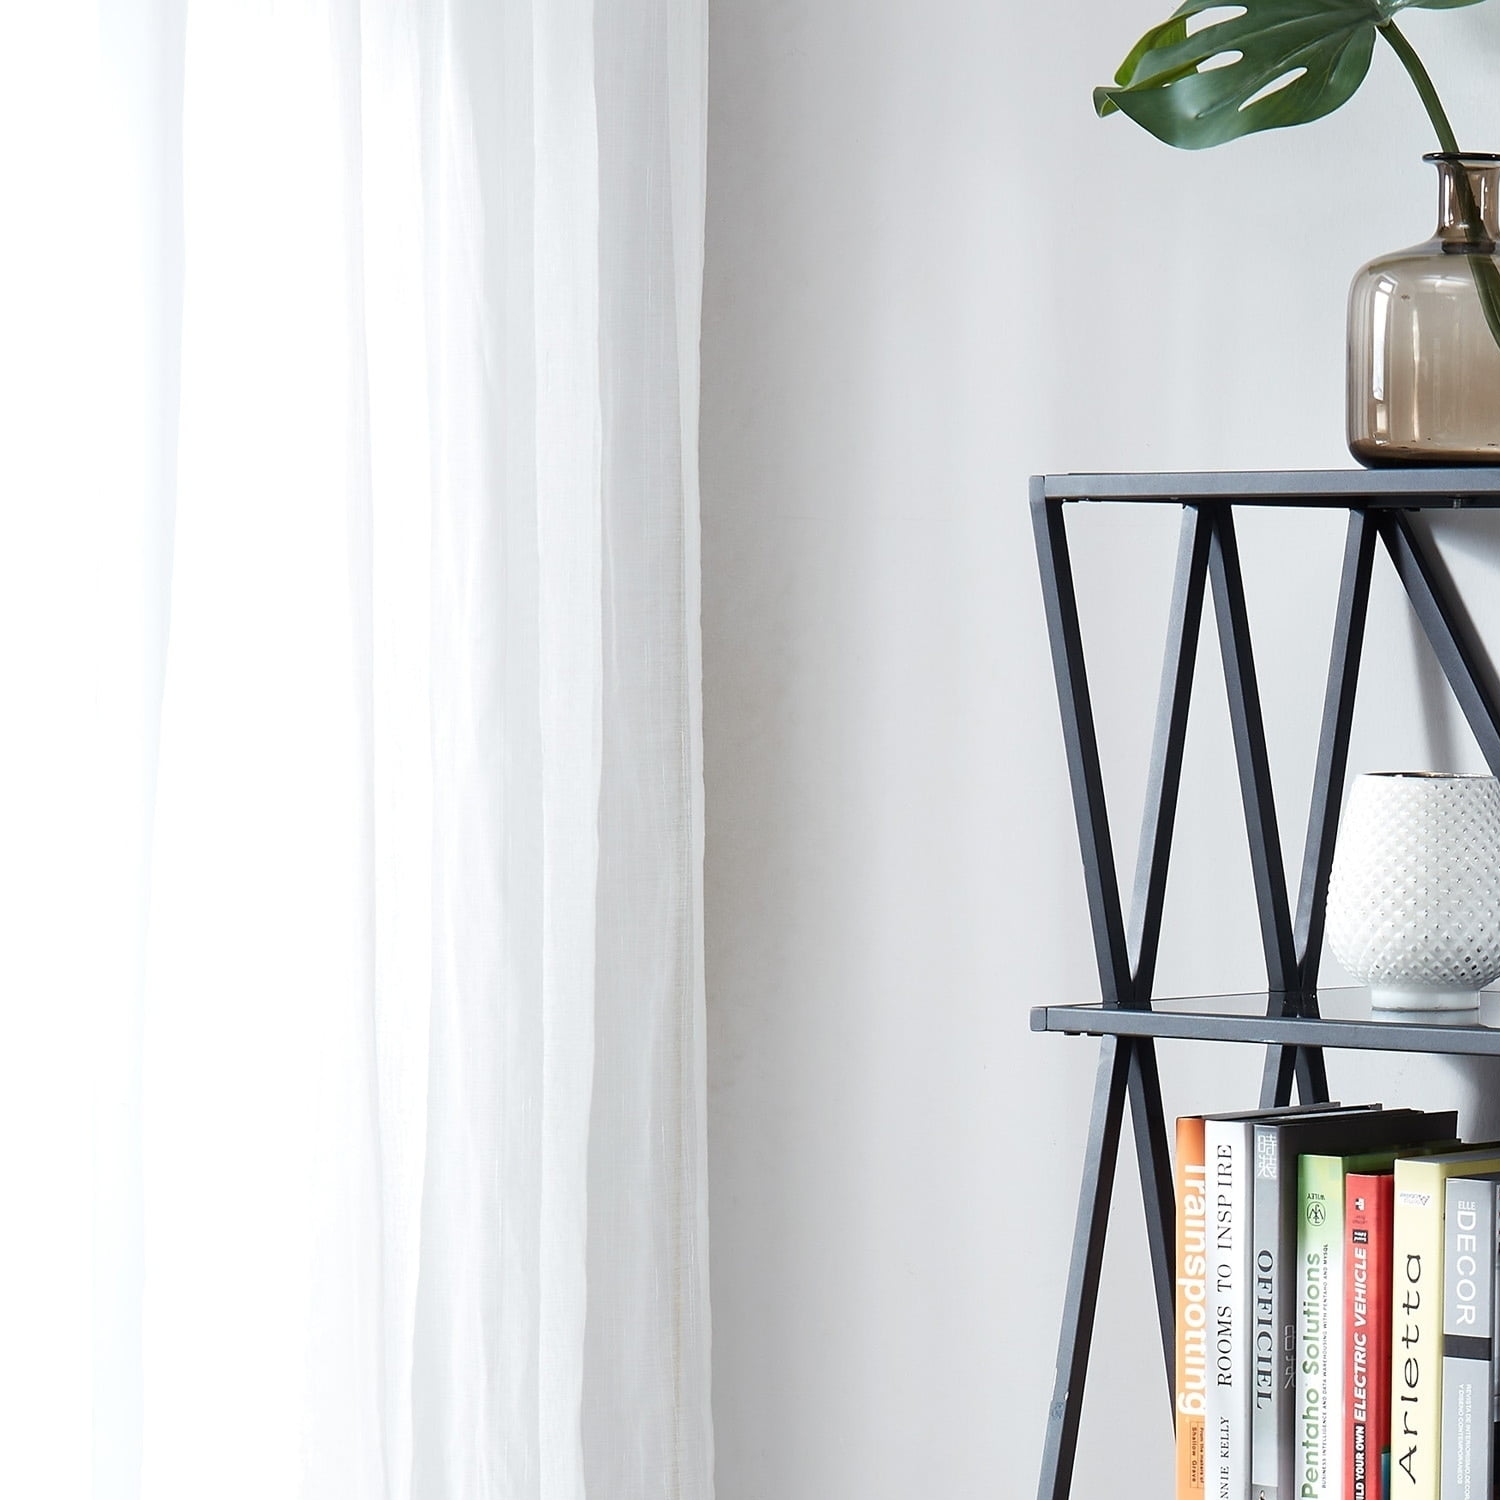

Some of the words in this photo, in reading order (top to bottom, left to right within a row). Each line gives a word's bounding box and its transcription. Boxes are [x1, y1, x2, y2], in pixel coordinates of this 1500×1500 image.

[1458, 1201, 1476, 1210] ELLE
[1217, 1264, 1232, 1293] TO
[1354, 1248, 1367, 1327] VEHICLE
[1456, 1210, 1476, 1325] DECOR
[1217, 1306, 1232, 1387] ROOMS
[1257, 1250, 1274, 1410] OFFICIEL
[1302, 1253, 1320, 1375] Solutions
[1354, 1332, 1367, 1422] ELECTRIC
[1220, 1416, 1230, 1458] KELLY
[1301, 1388, 1319, 1498] Pentaho
[1355, 1425, 1365, 1451] OWN
[1355, 1452, 1365, 1480] YOUR
